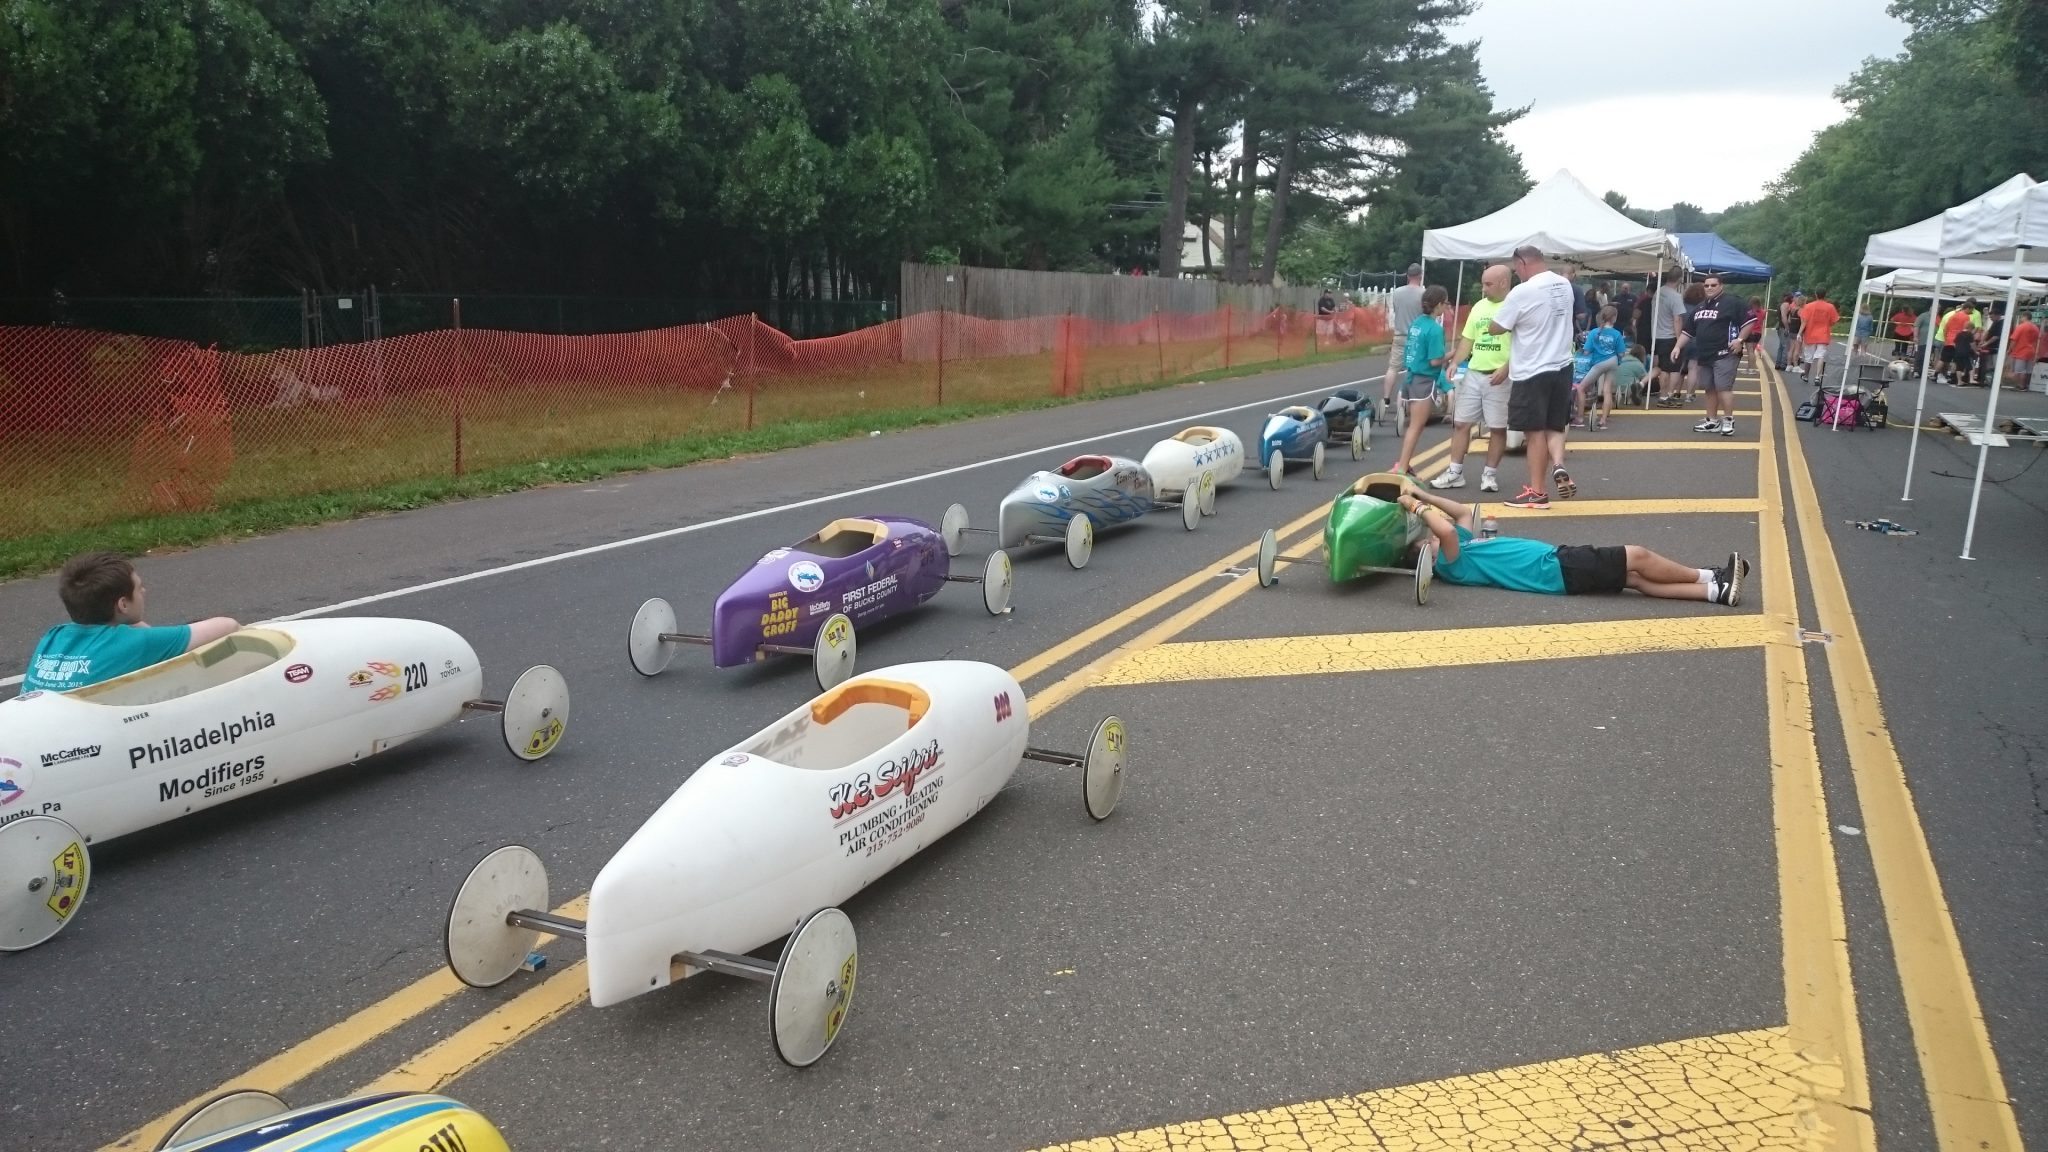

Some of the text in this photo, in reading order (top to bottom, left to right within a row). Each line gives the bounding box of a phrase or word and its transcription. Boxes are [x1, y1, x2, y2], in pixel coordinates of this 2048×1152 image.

[842, 574, 898, 604] FIRST FEDERAL
[843, 585, 898, 614] OF BUCKS COUNTY
[761, 607, 799, 626] DADDY
[771, 597, 789, 612] BIG
[763, 620, 798, 638] GROFF
[287, 666, 310, 678] TEAM
[404, 662, 428, 692] 220
[440, 667, 461, 679] TOYOTA
[123, 711, 150, 724] DRIVER
[129, 711, 276, 769] Philadelphia
[40, 745, 101, 764] McCafferty
[159, 754, 265, 802] Modifiers
[204, 771, 265, 798] Since 1955
[829, 739, 938, 819] K.E. Seifert
[42, 802, 62, 815] Pa
[839, 776, 944, 846] PLUMBING HEATING
[846, 791, 939, 857] AIR CONDITIONING
